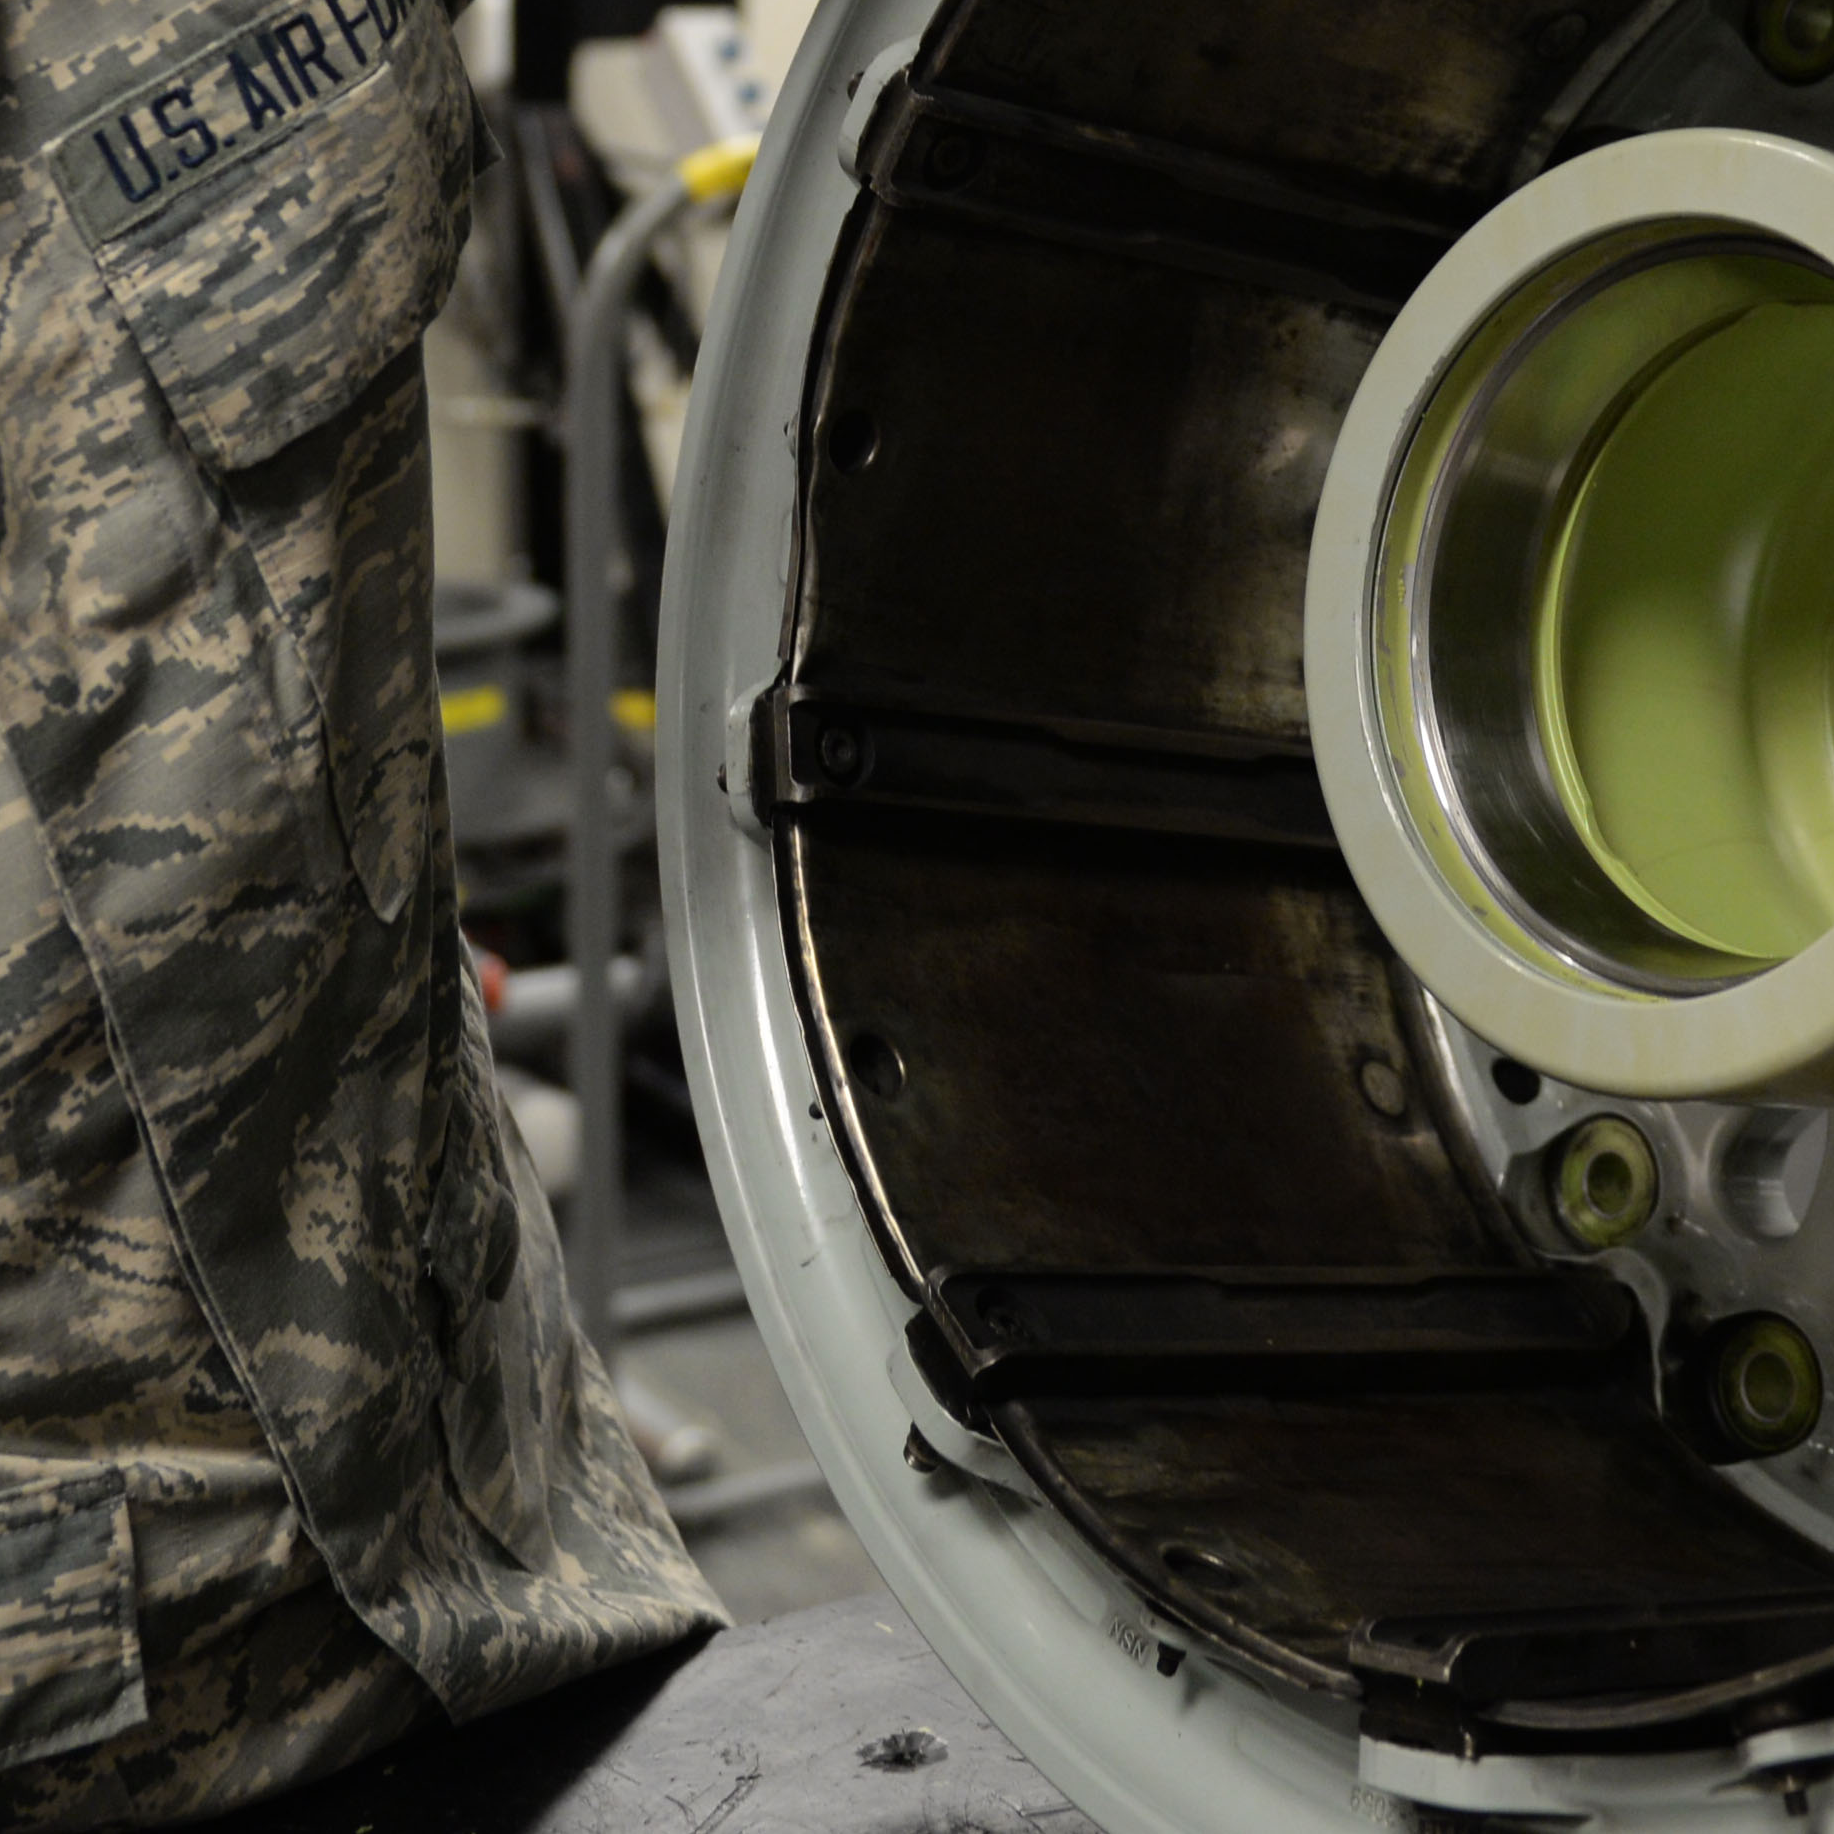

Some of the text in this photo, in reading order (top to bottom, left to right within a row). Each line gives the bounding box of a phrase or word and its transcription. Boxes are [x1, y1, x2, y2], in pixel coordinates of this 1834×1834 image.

[92, 88, 236, 204] U.S.
[227, 16, 344, 132] AIR
[1108, 1615, 1149, 1665] NSN
